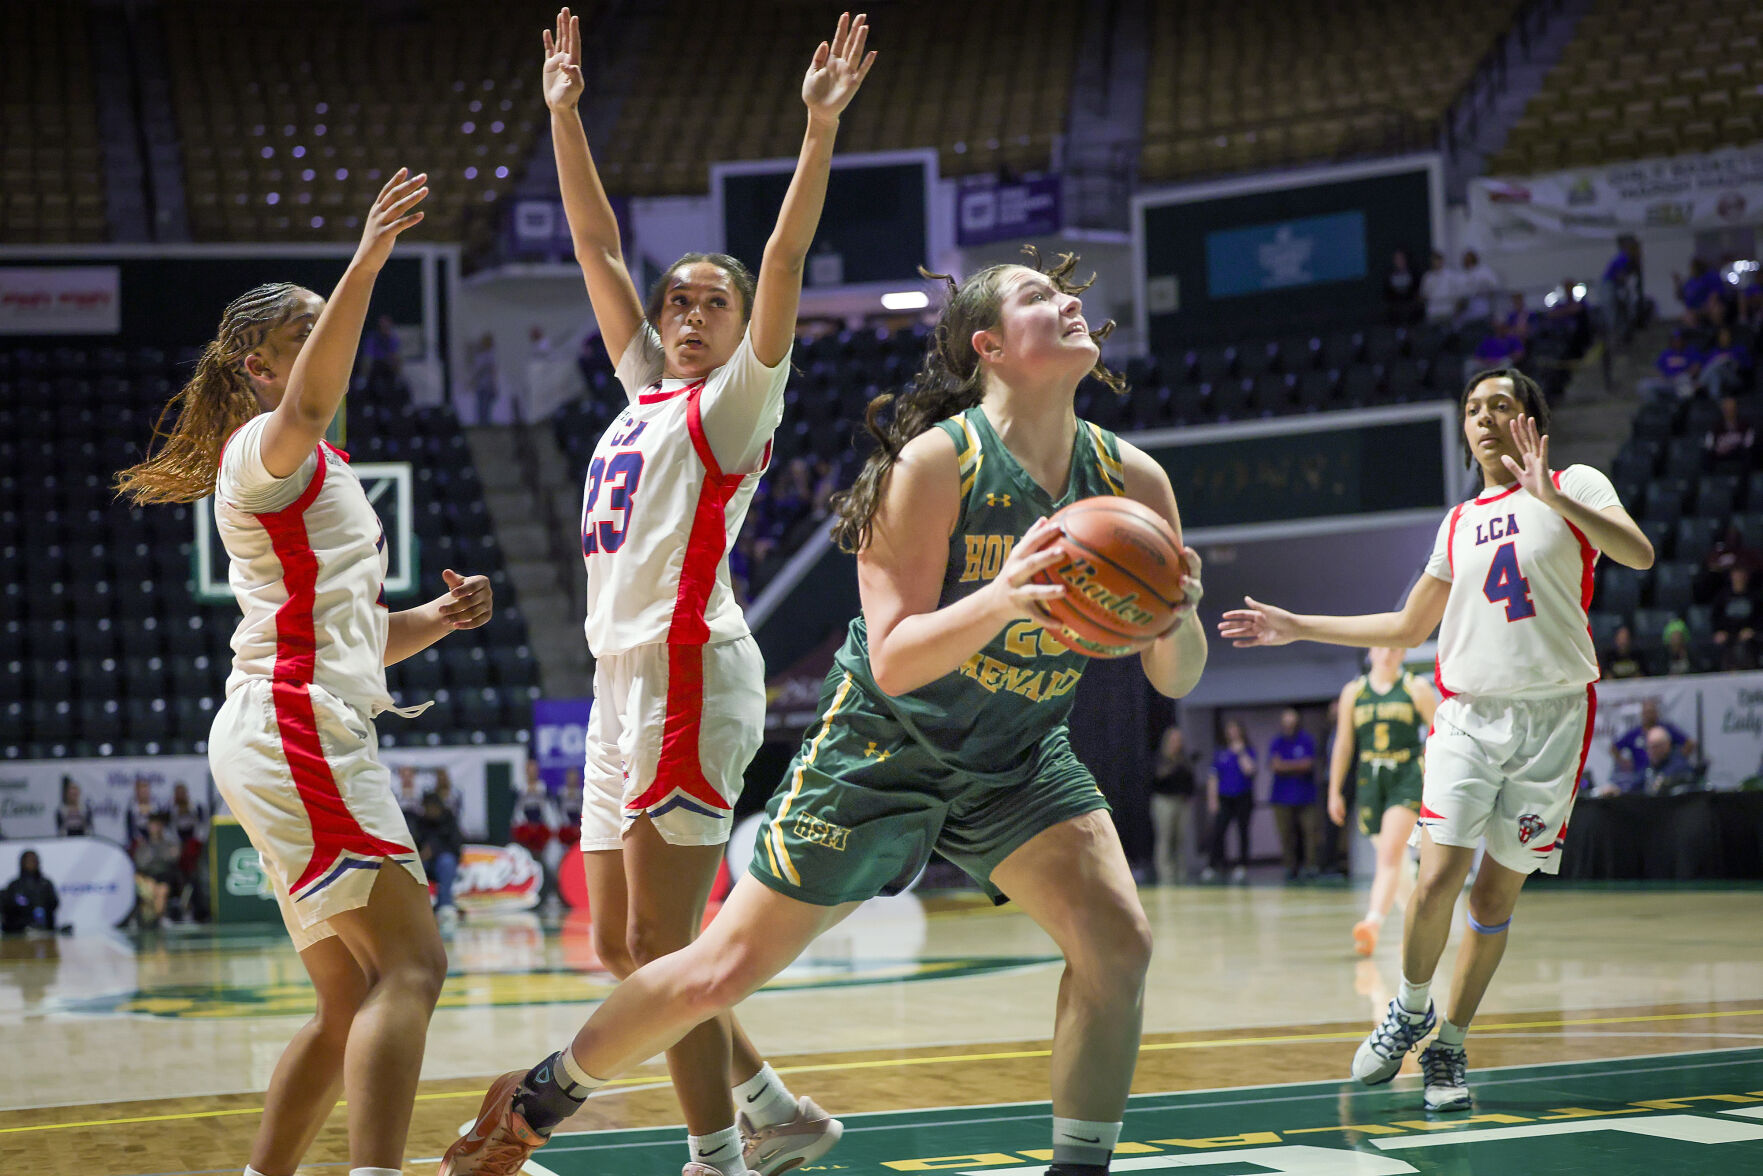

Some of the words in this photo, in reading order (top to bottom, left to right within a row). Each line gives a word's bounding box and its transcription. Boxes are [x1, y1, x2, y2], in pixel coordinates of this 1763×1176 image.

[582, 451, 645, 557] 23
[1475, 513, 1520, 546] LCA
[959, 534, 1024, 582] HOL
[1058, 556, 1155, 627] Baden
[1483, 541, 1537, 623] 4
[793, 810, 852, 851] HSM
[881, 1090, 1763, 1171] UTHLAND
